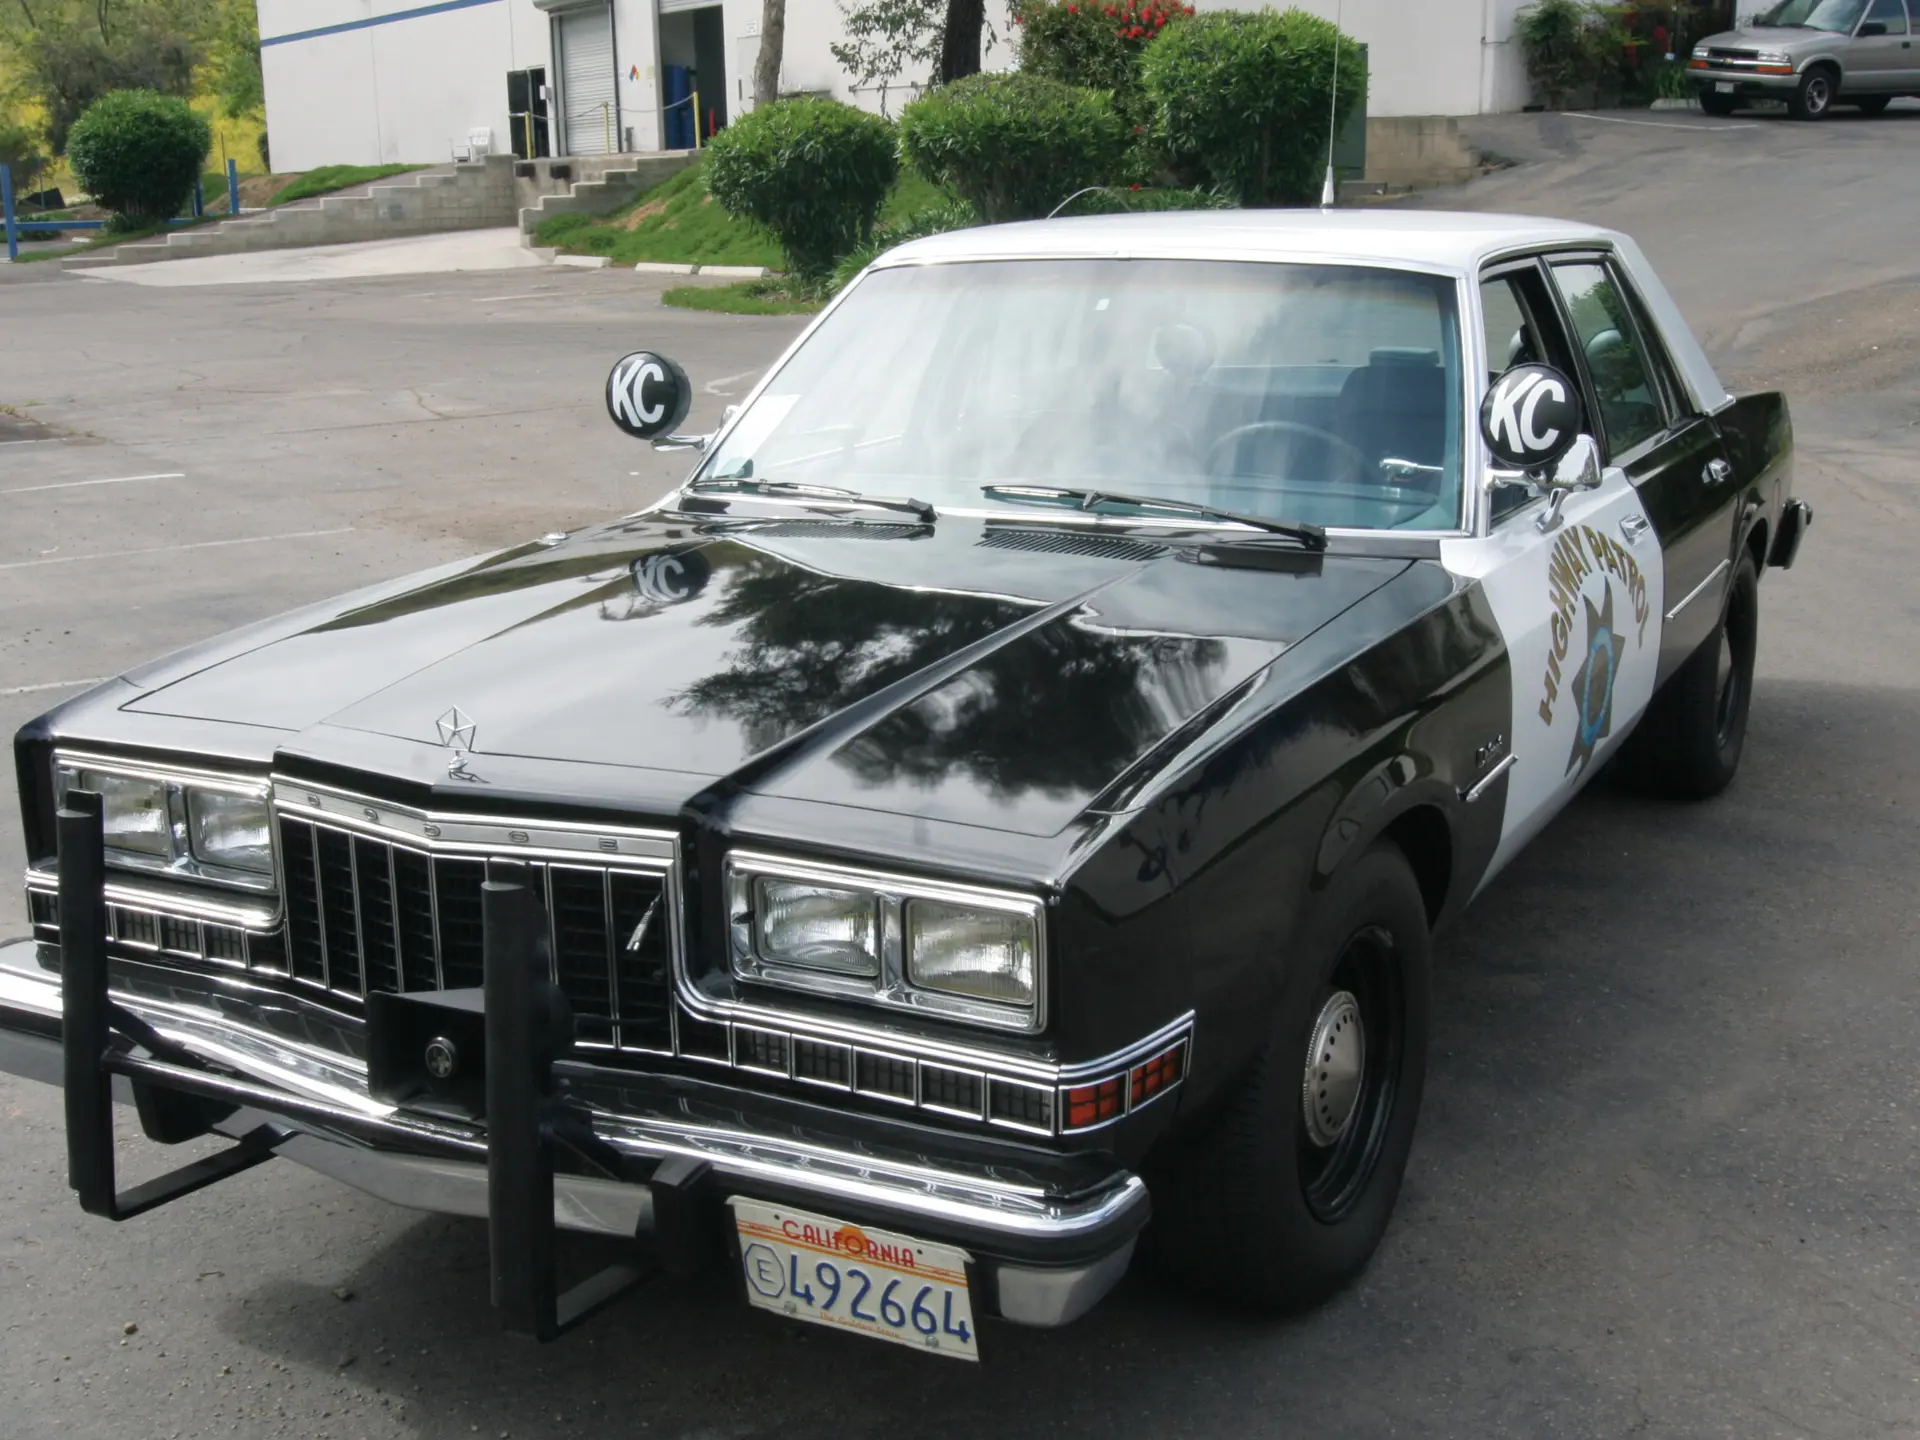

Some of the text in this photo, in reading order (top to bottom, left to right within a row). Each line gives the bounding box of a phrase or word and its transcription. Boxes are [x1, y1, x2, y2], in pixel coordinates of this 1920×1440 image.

[612, 360, 665, 427] KC
[1490, 373, 1565, 453] KC
[1538, 525, 1649, 727] HIGHWAY PATROL
[783, 1220, 915, 1268] CALIFORNIA
[790, 1254, 971, 1343] 492664
